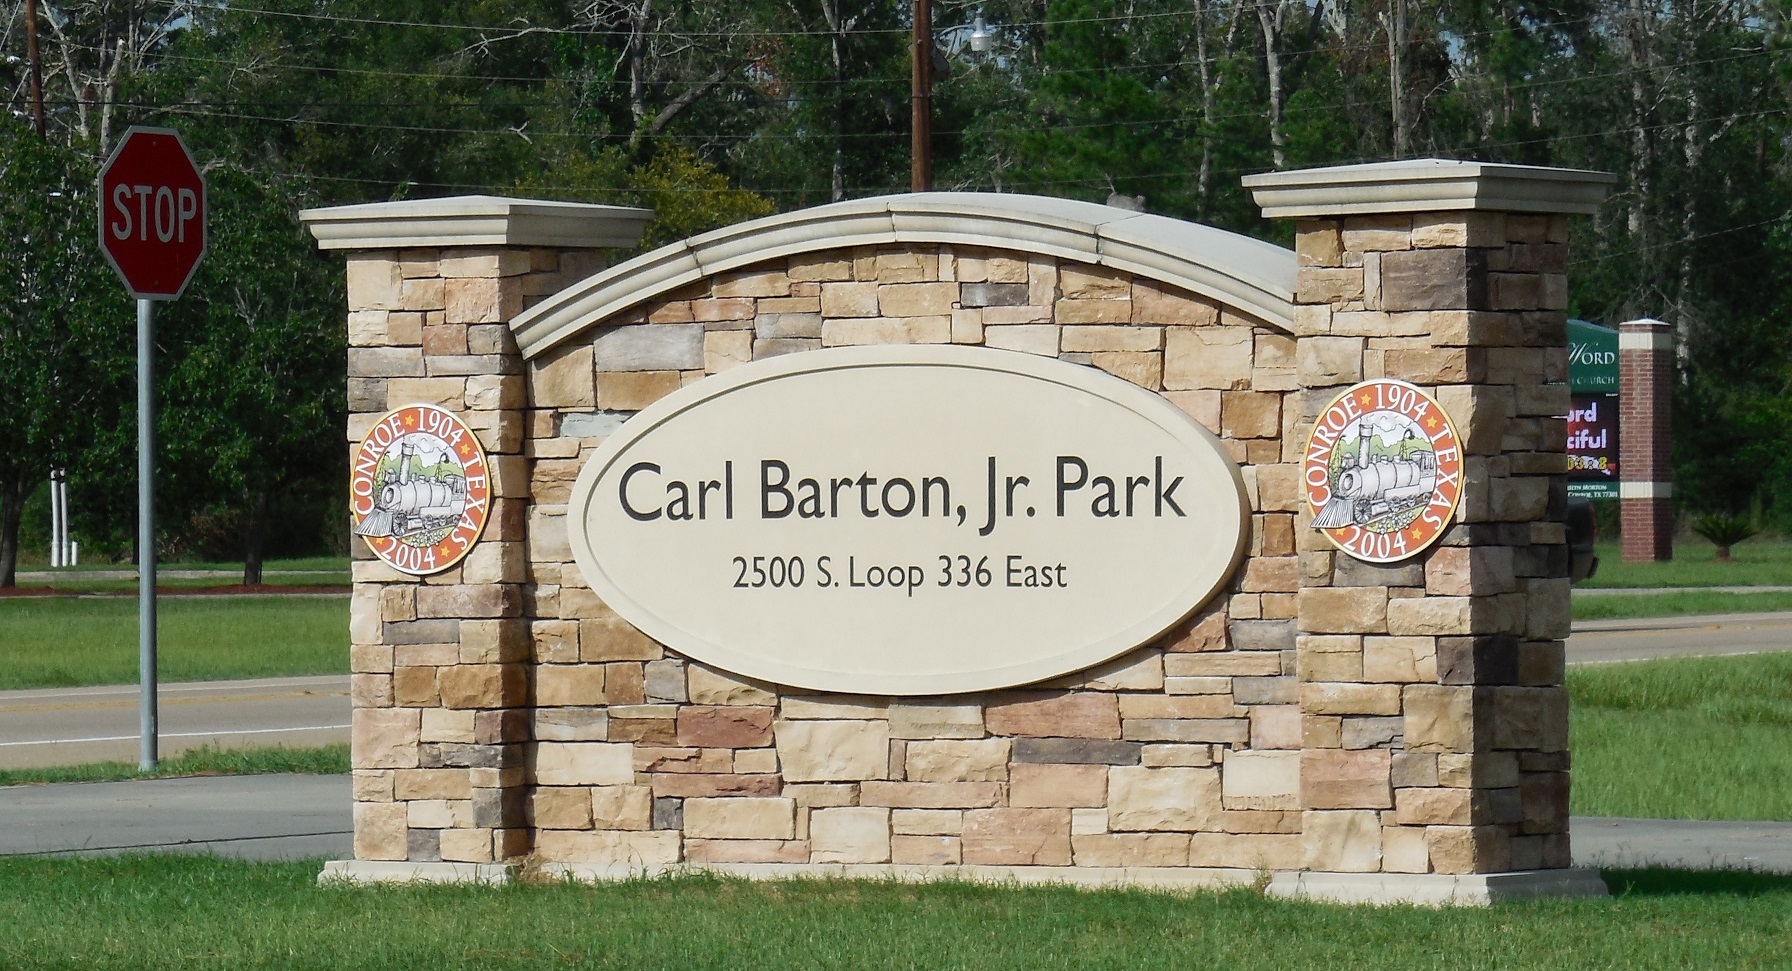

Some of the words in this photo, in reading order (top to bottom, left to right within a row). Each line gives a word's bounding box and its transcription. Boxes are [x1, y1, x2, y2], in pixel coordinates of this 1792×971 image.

[111, 183, 197, 243] STOP
[1576, 376, 1615, 385] CURCH
[353, 412, 406, 515] CONROE
[417, 407, 465, 447] 1904
[451, 451, 486, 550] TEXAS
[1305, 393, 1362, 507] CONROE
[1375, 384, 1430, 422] 1904
[1422, 423, 1459, 531] TEXAS
[618, 460, 733, 522] Carl
[760, 459, 967, 527] Barton,
[978, 456, 1036, 537] Jr.
[1056, 455, 1187, 518] Park
[380, 536, 435, 570] 2004
[1343, 525, 1406, 559] 2004
[732, 556, 805, 588] 2500
[817, 555, 839, 588] S.
[849, 555, 925, 598] Loop
[937, 554, 992, 588] 336
[1006, 555, 1068, 588] East
